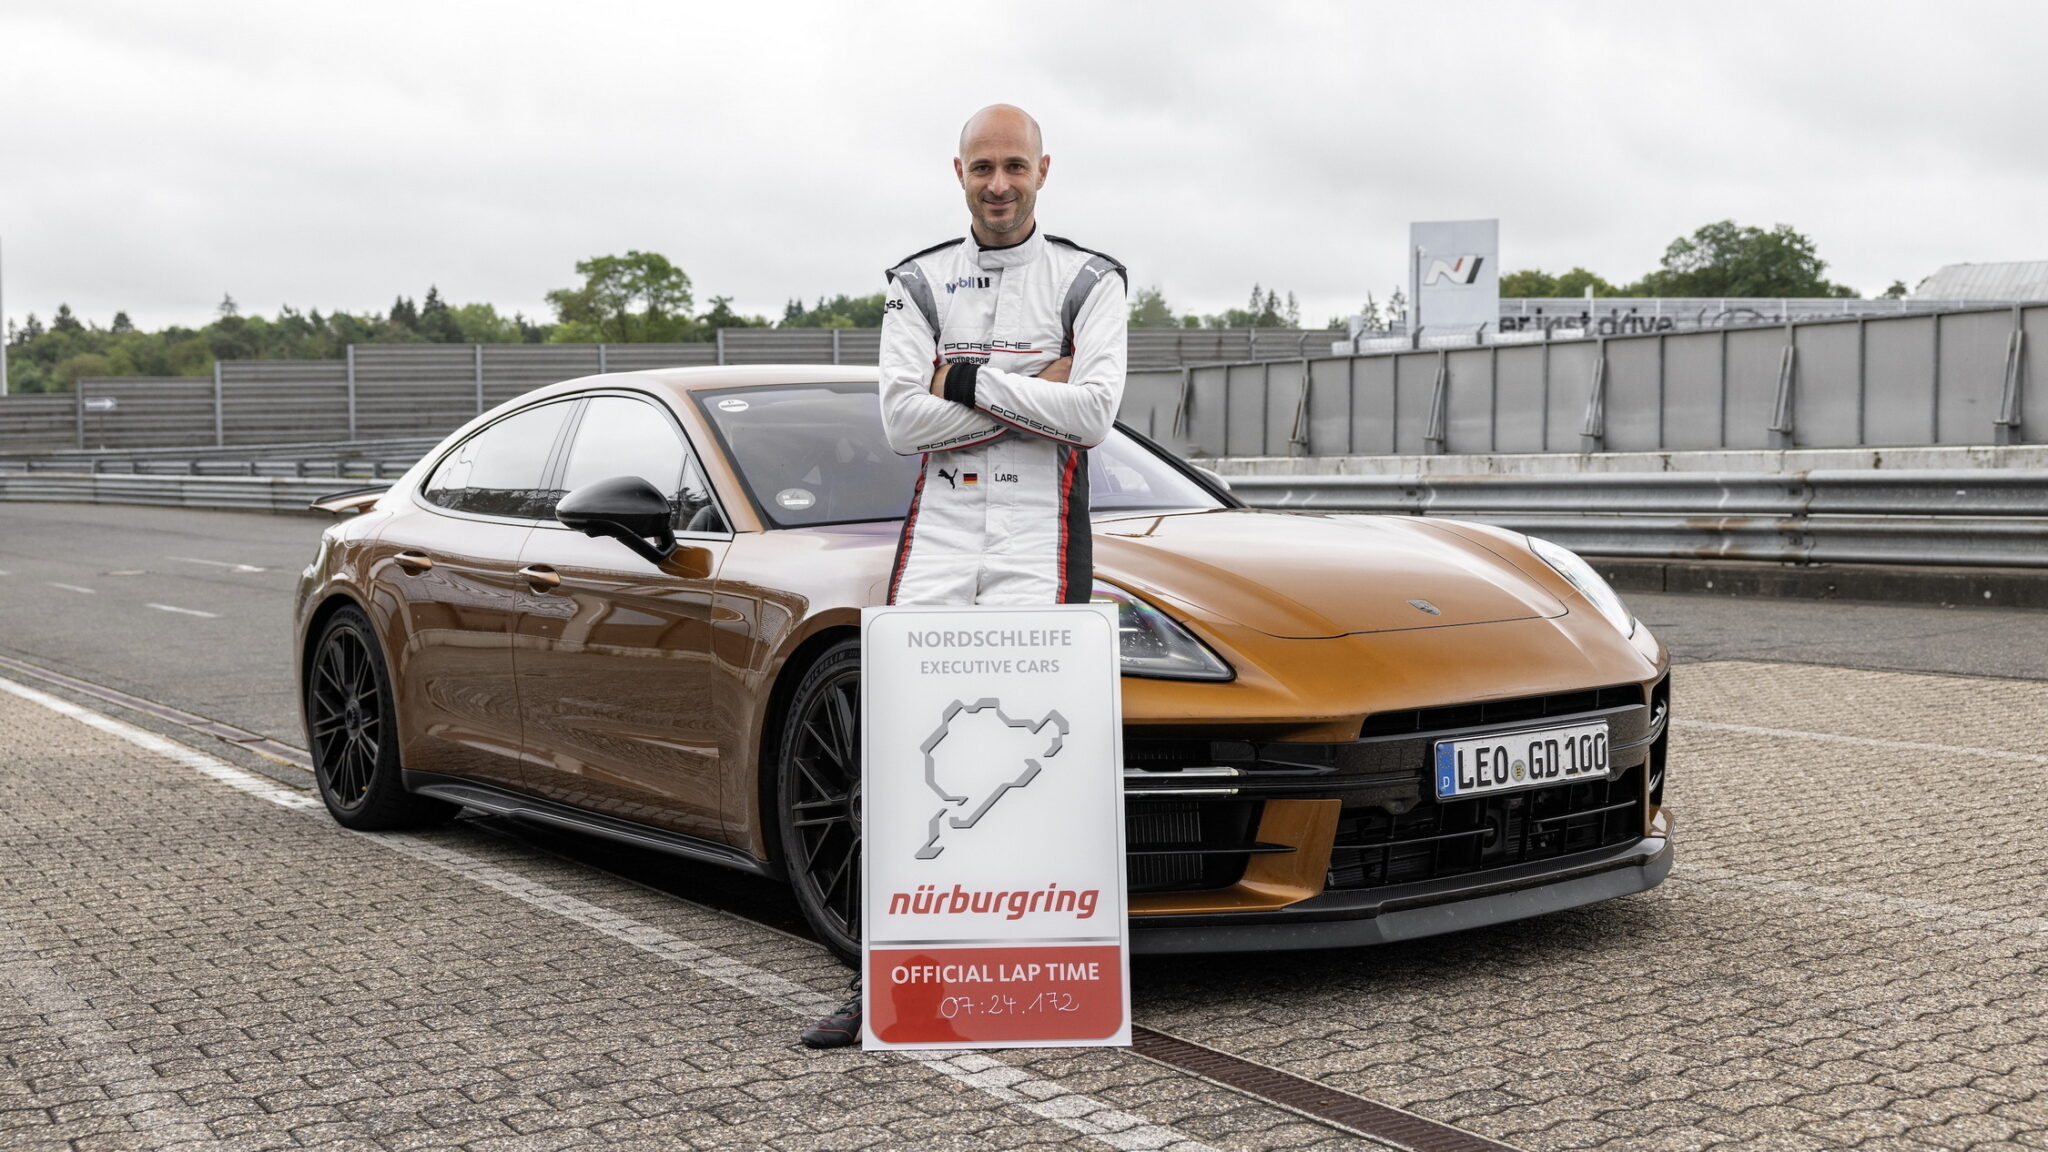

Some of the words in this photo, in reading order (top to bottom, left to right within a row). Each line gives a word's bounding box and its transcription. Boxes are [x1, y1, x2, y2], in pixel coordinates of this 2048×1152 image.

[945, 276, 975, 294] Mbil
[1599, 307, 1674, 335] drive
[944, 340, 1032, 352] PORSCHE
[945, 356, 991, 365] MOTORSPOR
[990, 404, 1083, 443] PORSCHE
[994, 472, 1019, 483] LARS
[907, 629, 1072, 648] NORDSCHLEIFE
[920, 660, 1012, 675] EXECUTIVE
[1015, 659, 1060, 674] CARS
[1457, 745, 1509, 790] LEO
[1565, 732, 1607, 776] 100
[1442, 775, 1450, 788] D
[888, 882, 1100, 921] nürburgring
[891, 964, 994, 985] OFFICIAL
[999, 963, 1042, 983] LAP
[1045, 962, 1100, 981] TIME
[940, 991, 1081, 1020] 07:24.172
